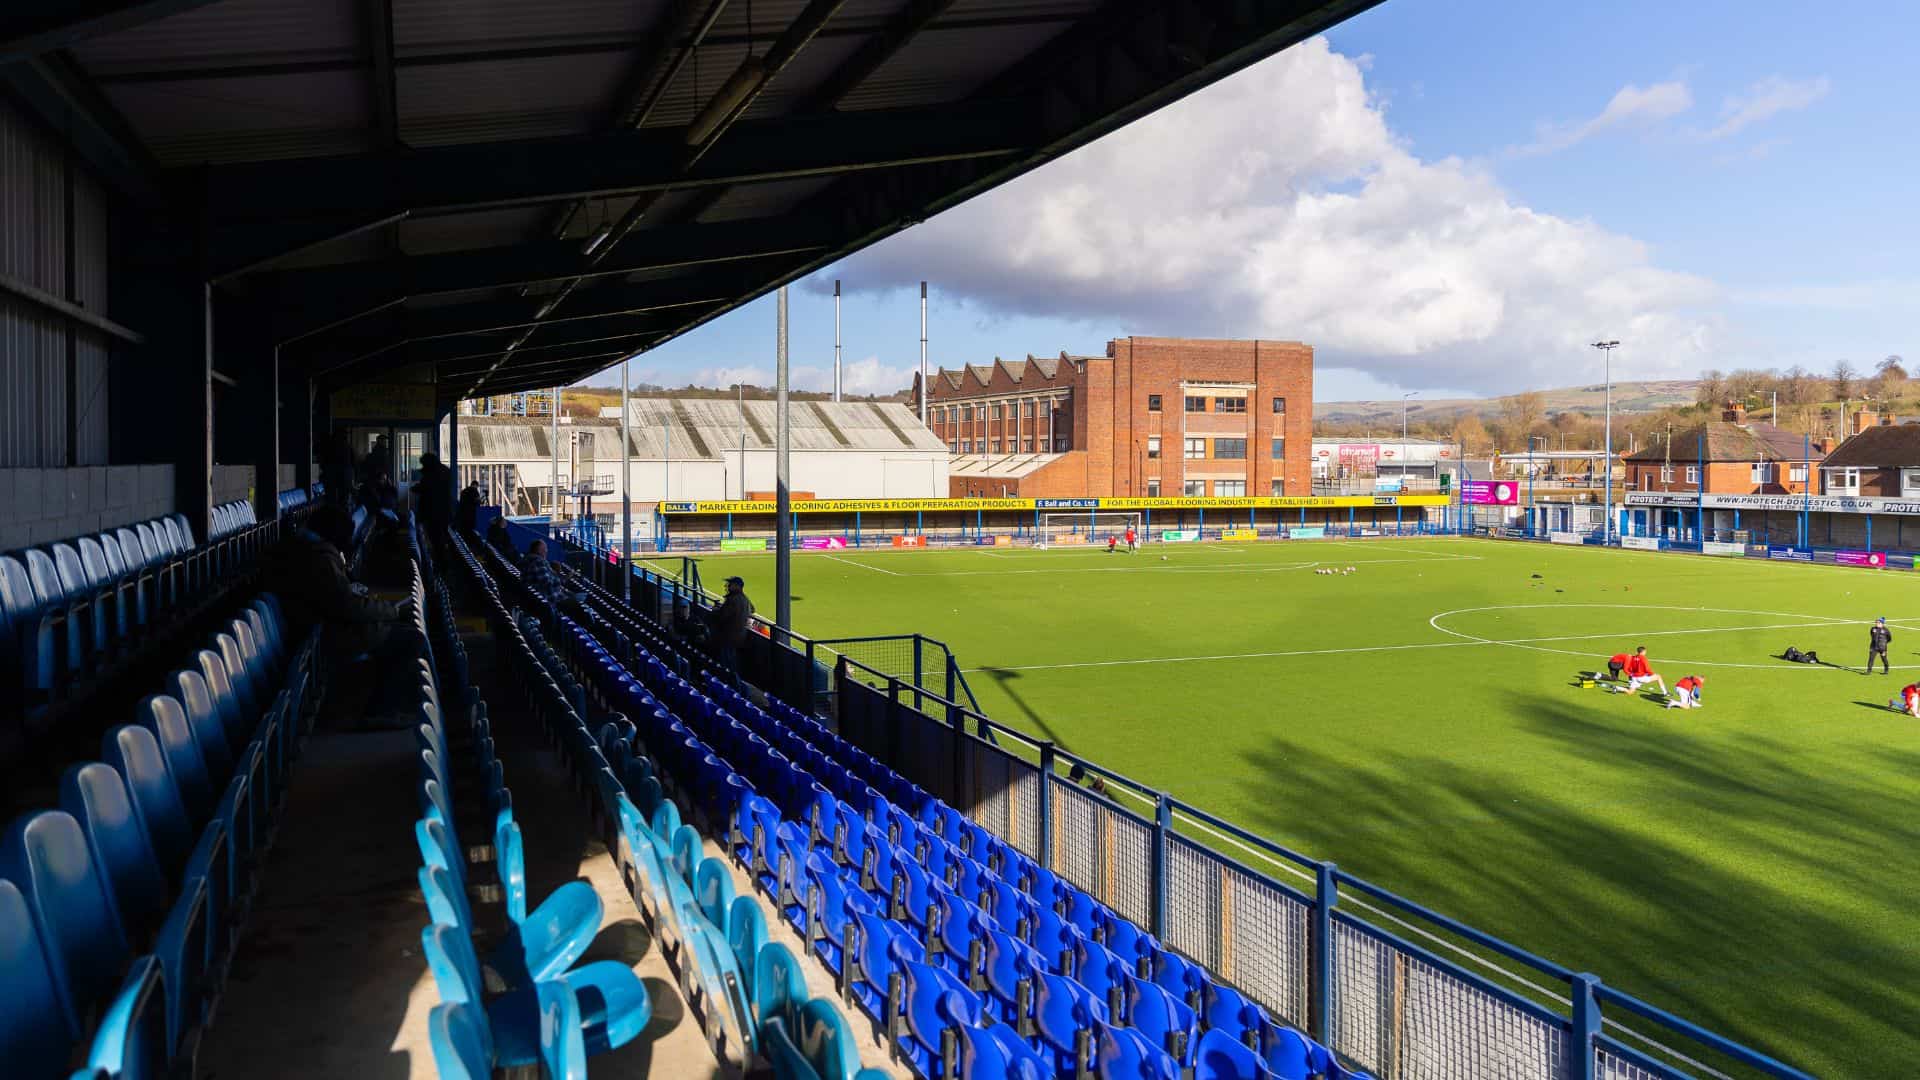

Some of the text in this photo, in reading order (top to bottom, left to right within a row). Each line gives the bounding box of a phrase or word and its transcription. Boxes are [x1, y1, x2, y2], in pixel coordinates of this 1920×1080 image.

[1045, 499, 1057, 507] Ball
[1058, 499, 1071, 507] and
[1629, 496, 1664, 504] PROTECH
[666, 503, 688, 511] BALL
[700, 503, 738, 511] MARKET
[741, 503, 777, 511] LEADIN
[789, 502, 831, 510] LOORING
[833, 502, 881, 510] ADHESIVES
[891, 501, 921, 509] FLOOR
[982, 500, 1027, 508] PRODUCTS
[1884, 503, 1920, 512] PROTE
